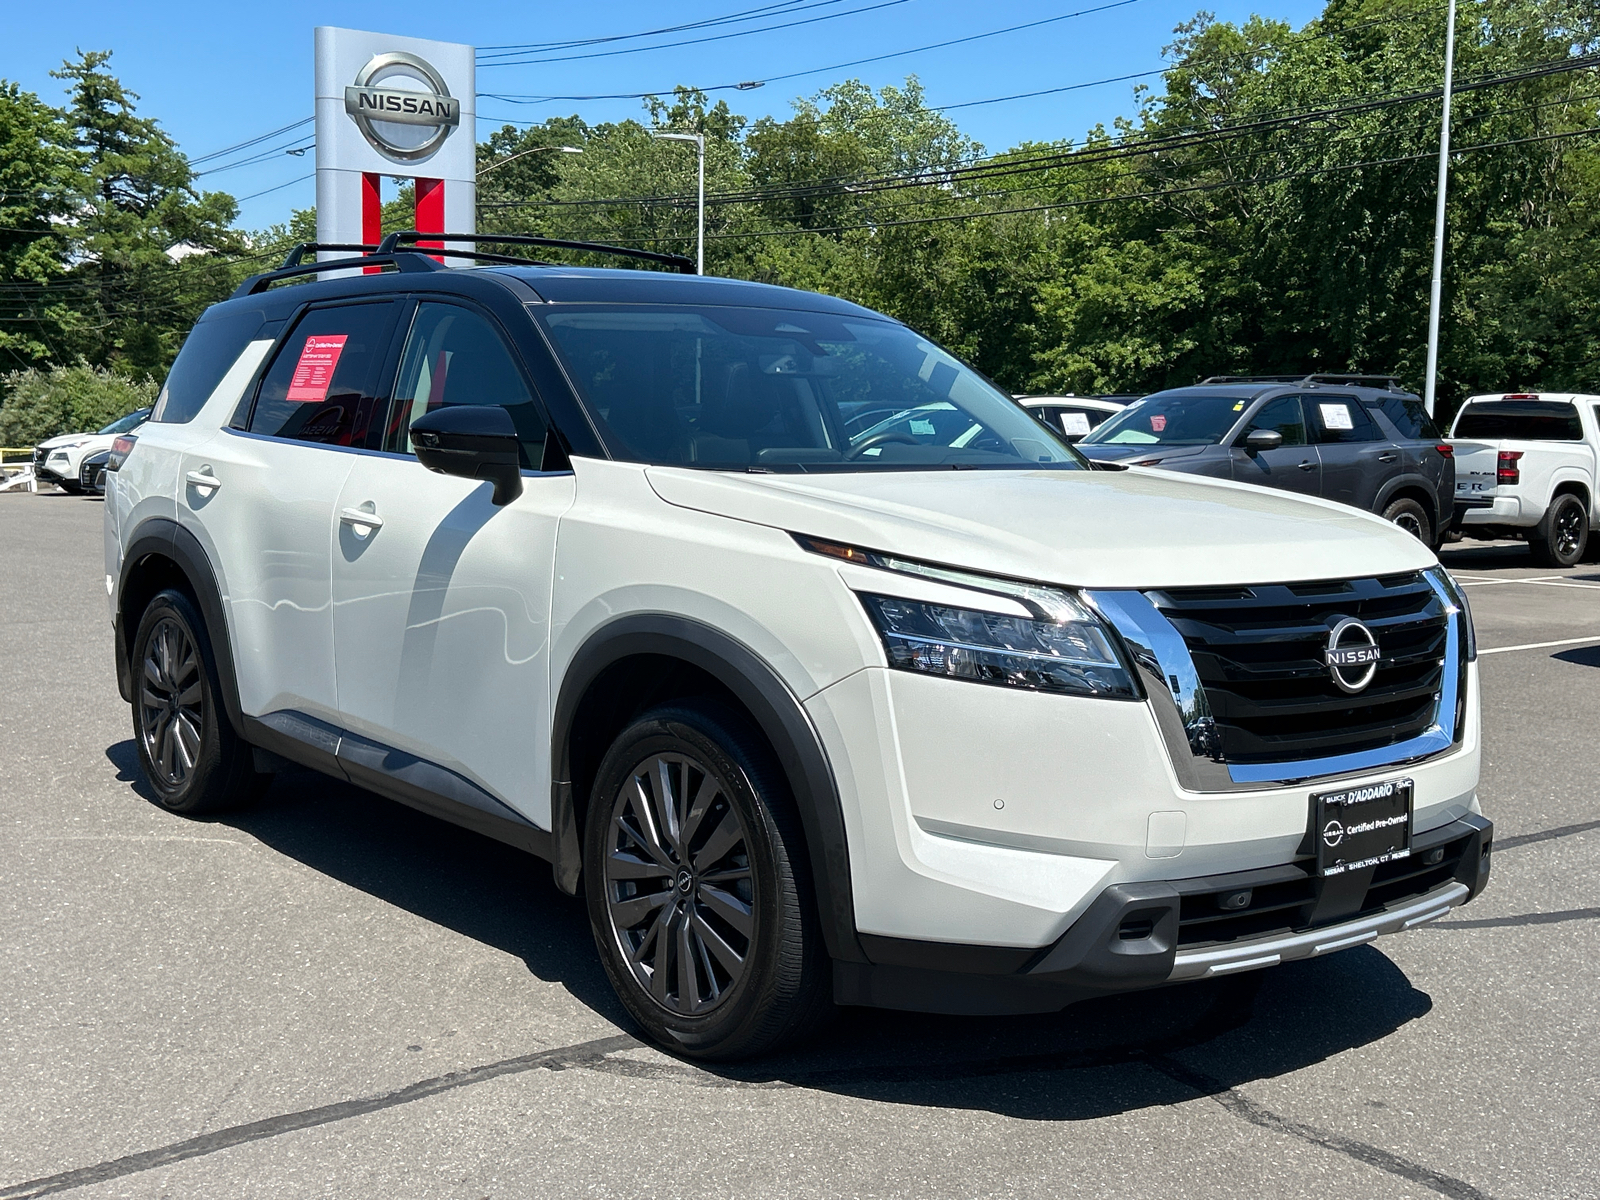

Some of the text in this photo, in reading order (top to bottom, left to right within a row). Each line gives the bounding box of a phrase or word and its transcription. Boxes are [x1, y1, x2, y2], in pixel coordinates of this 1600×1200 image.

[359, 93, 451, 118] NISSAN
[1328, 648, 1380, 664] NISSAN
[1347, 784, 1393, 804] D'ADDARIO
[1346, 813, 1408, 835] Certified Pre-Owned
[1323, 829, 1344, 838] NISSAN
[1324, 866, 1345, 876] NISSAN
